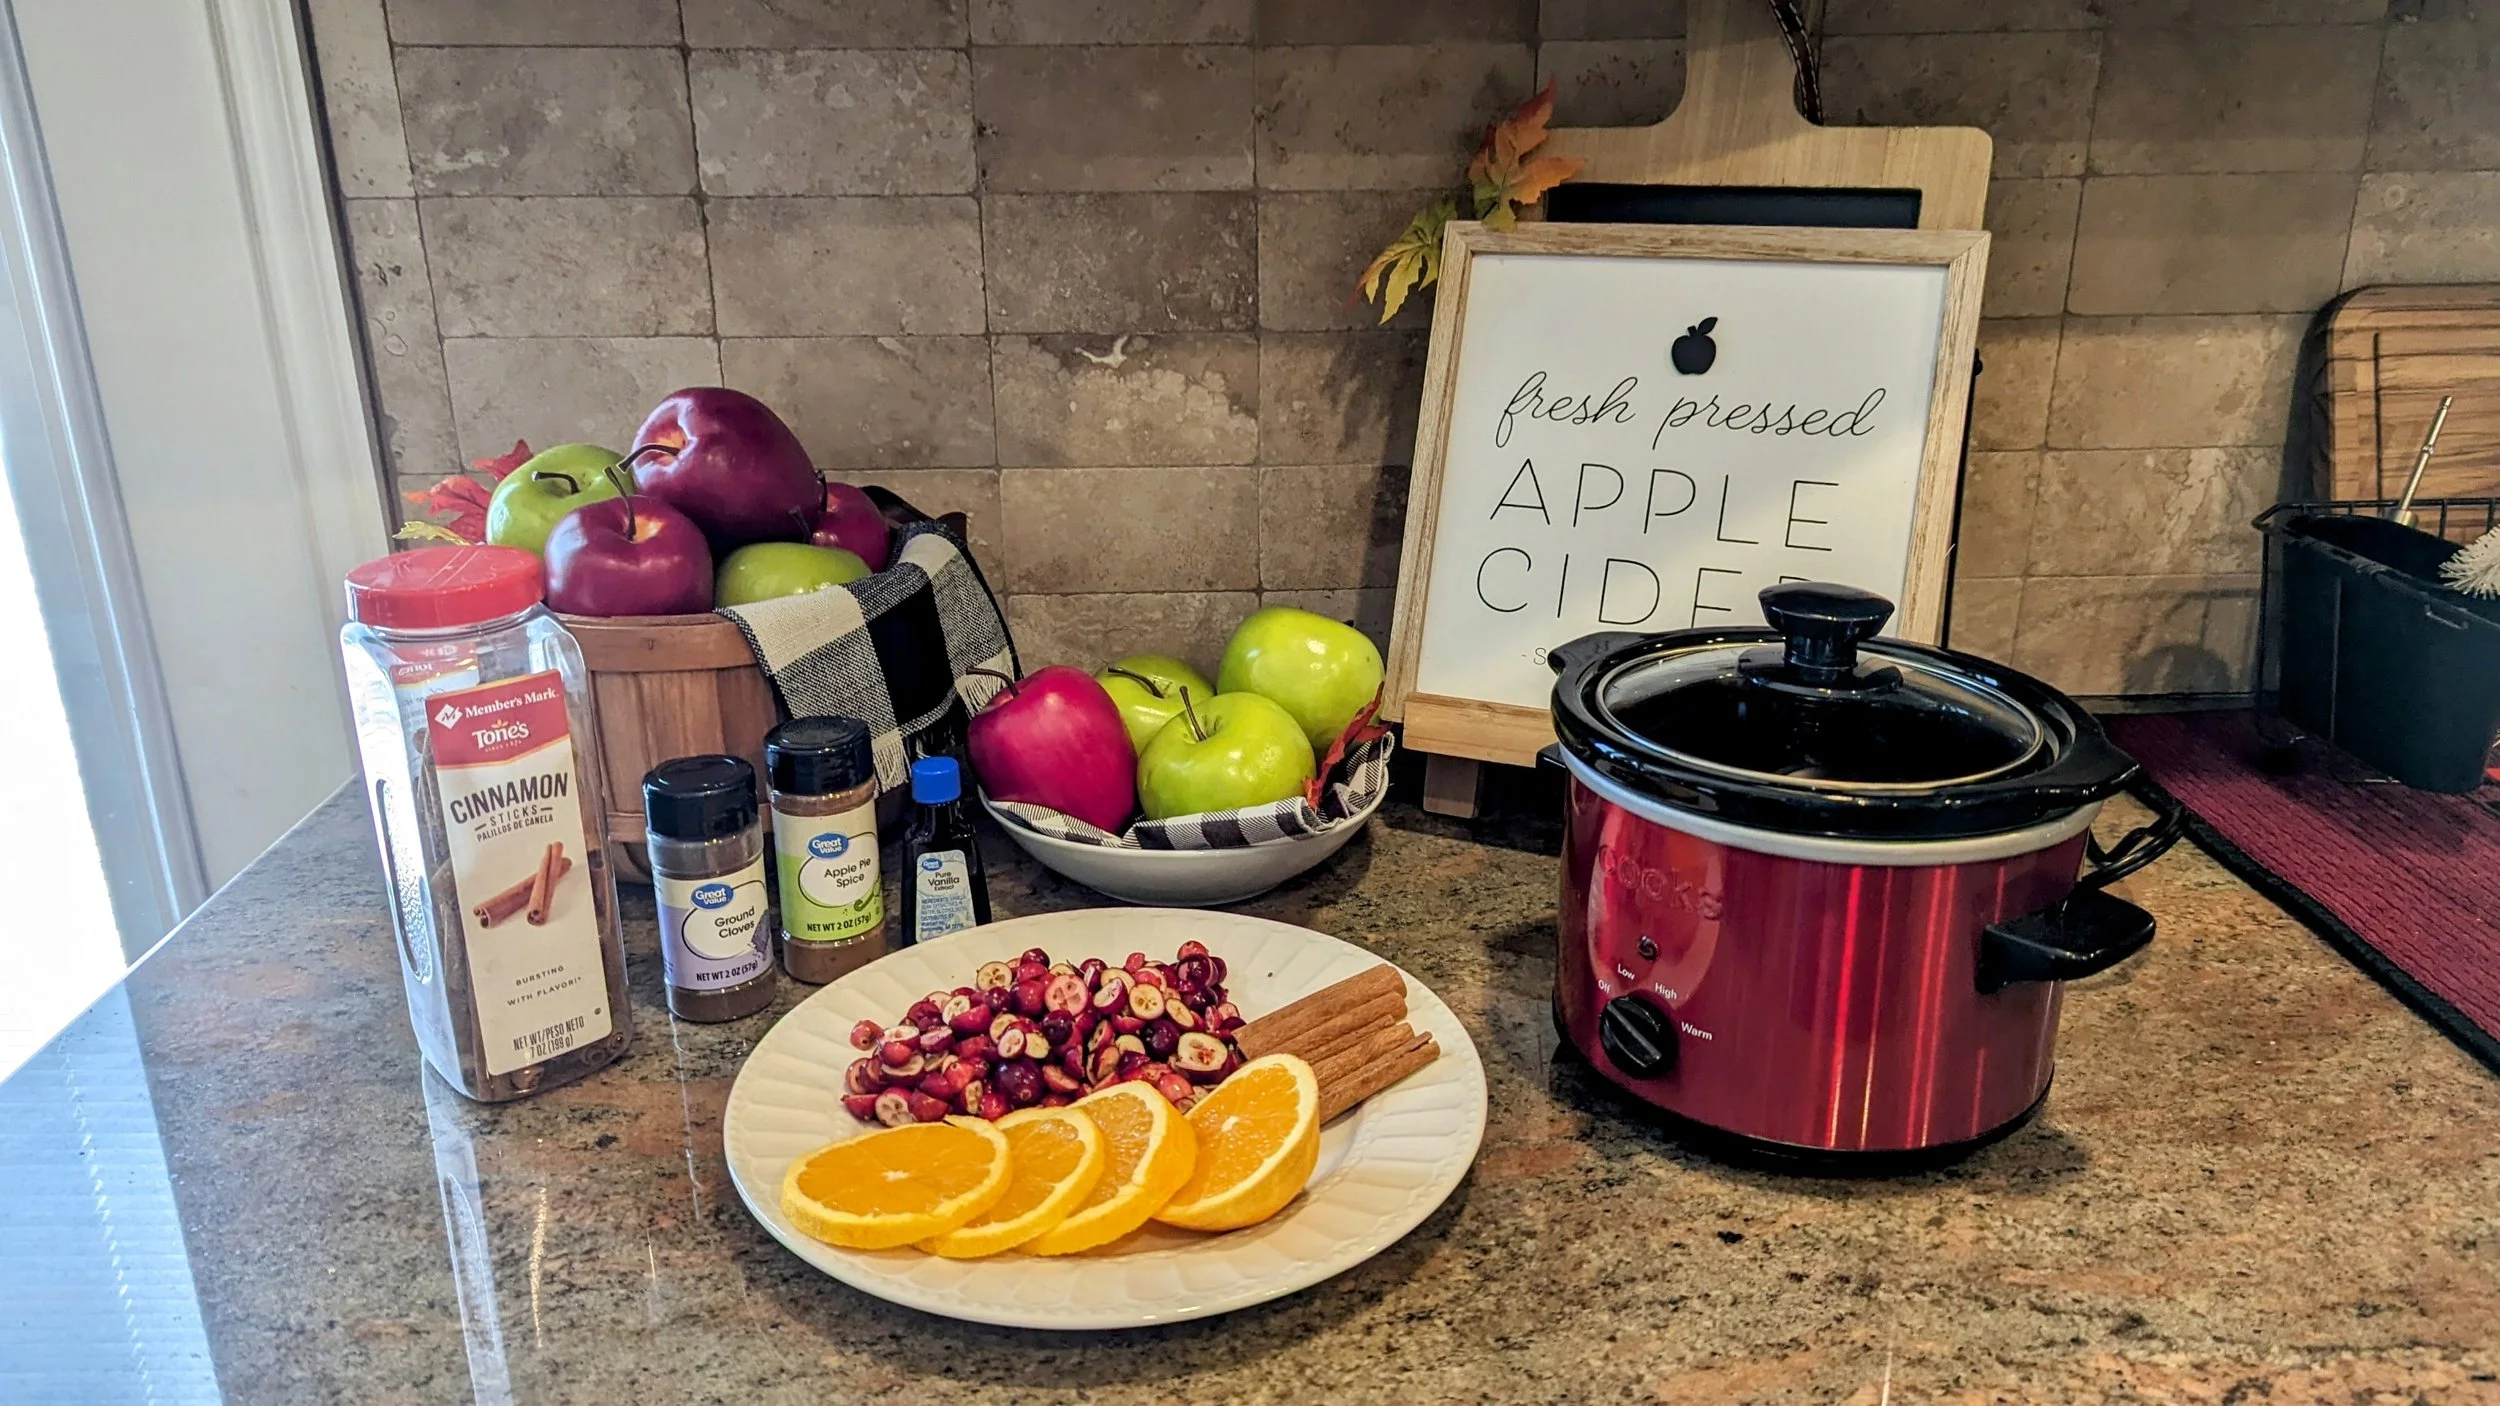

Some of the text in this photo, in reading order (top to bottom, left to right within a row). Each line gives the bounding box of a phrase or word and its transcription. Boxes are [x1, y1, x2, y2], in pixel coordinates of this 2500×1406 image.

[1495, 371, 1886, 450] fresh pressed
[1490, 458, 1840, 551] APPLE
[1476, 547, 1814, 629] CIDE
[465, 687, 557, 718] Member's Mark
[472, 720, 530, 749] Tone's
[450, 772, 568, 824] CINNAMON
[489, 804, 537, 827] STICKS
[476, 814, 553, 842] PALILLOS DE CANELA
[812, 837, 842, 849] Great
[820, 846, 842, 854] Value
[824, 858, 871, 879] Apple Pie
[836, 873, 865, 889] Spice
[928, 877, 960, 886] Vanilla
[695, 887, 726, 901] Great
[703, 896, 727, 905] Value
[714, 906, 755, 927] Ground
[807, 912, 872, 932] NET WT 2 OZ (57g)
[719, 920, 755, 938] Cloves
[516, 965, 565, 986] BURSTING
[696, 960, 759, 981] NET WT 2 OZ (57g)
[1617, 963, 1636, 980] Low
[1598, 979, 1611, 994] Off
[1655, 982, 1678, 999] High
[507, 993, 533, 1006] WITH
[513, 1016, 585, 1051] NET WT/PESO NETO
[1681, 1021, 1713, 1041] Warm
[530, 1033, 575, 1058] 7 OZ (199 g)
